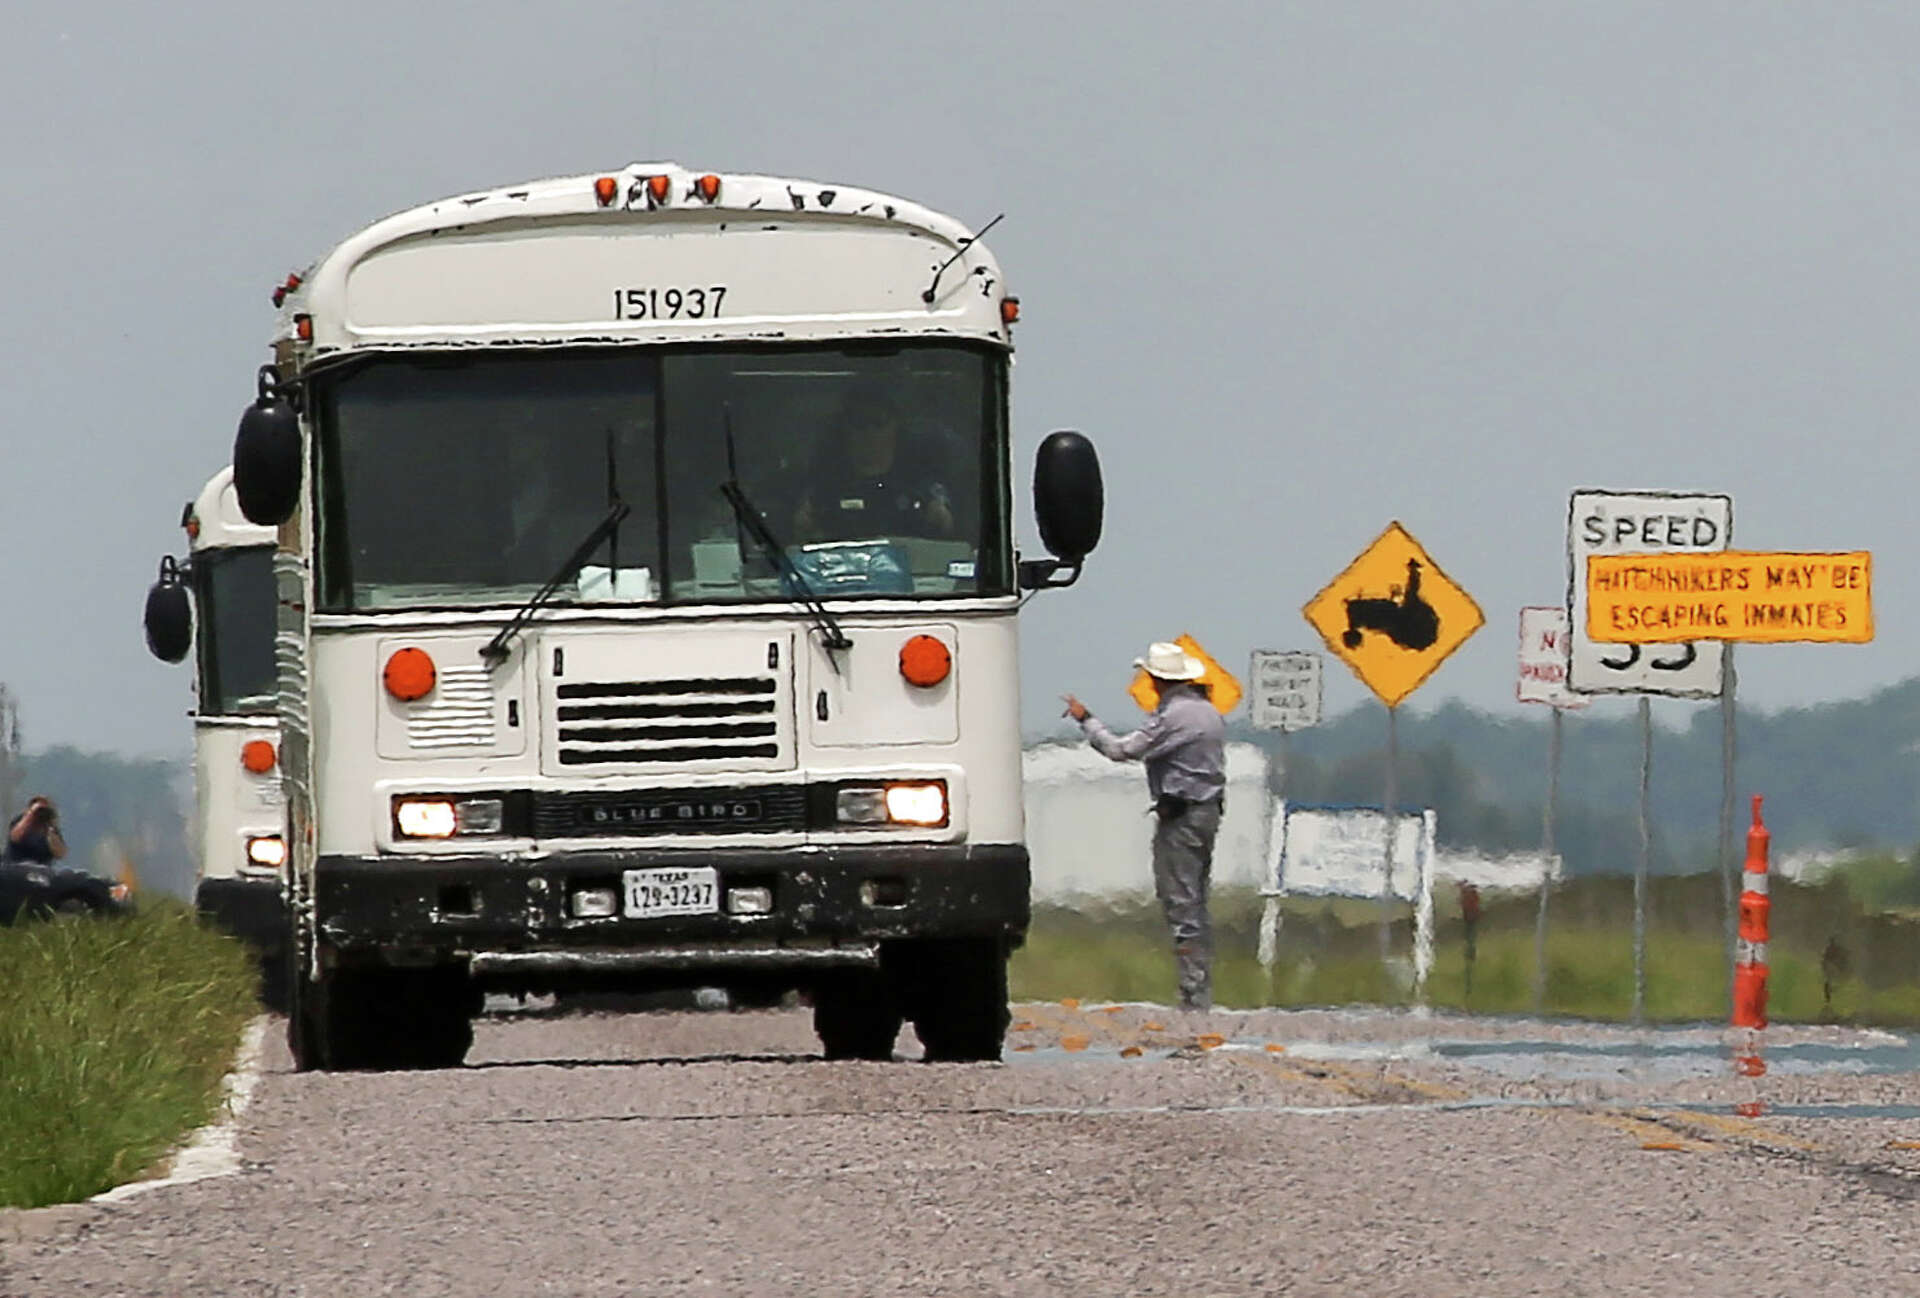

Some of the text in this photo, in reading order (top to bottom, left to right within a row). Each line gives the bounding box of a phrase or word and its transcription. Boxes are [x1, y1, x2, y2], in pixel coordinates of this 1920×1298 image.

[614, 287, 727, 319] 151937
[1583, 515, 1718, 547] SPEED
[1594, 564, 1863, 592] HITCHHIKERS MAY BE
[1611, 603, 1848, 631] ESCAPING INMATES
[594, 804, 748, 822] BLUE BIRD
[652, 872, 689, 882] TEXAS
